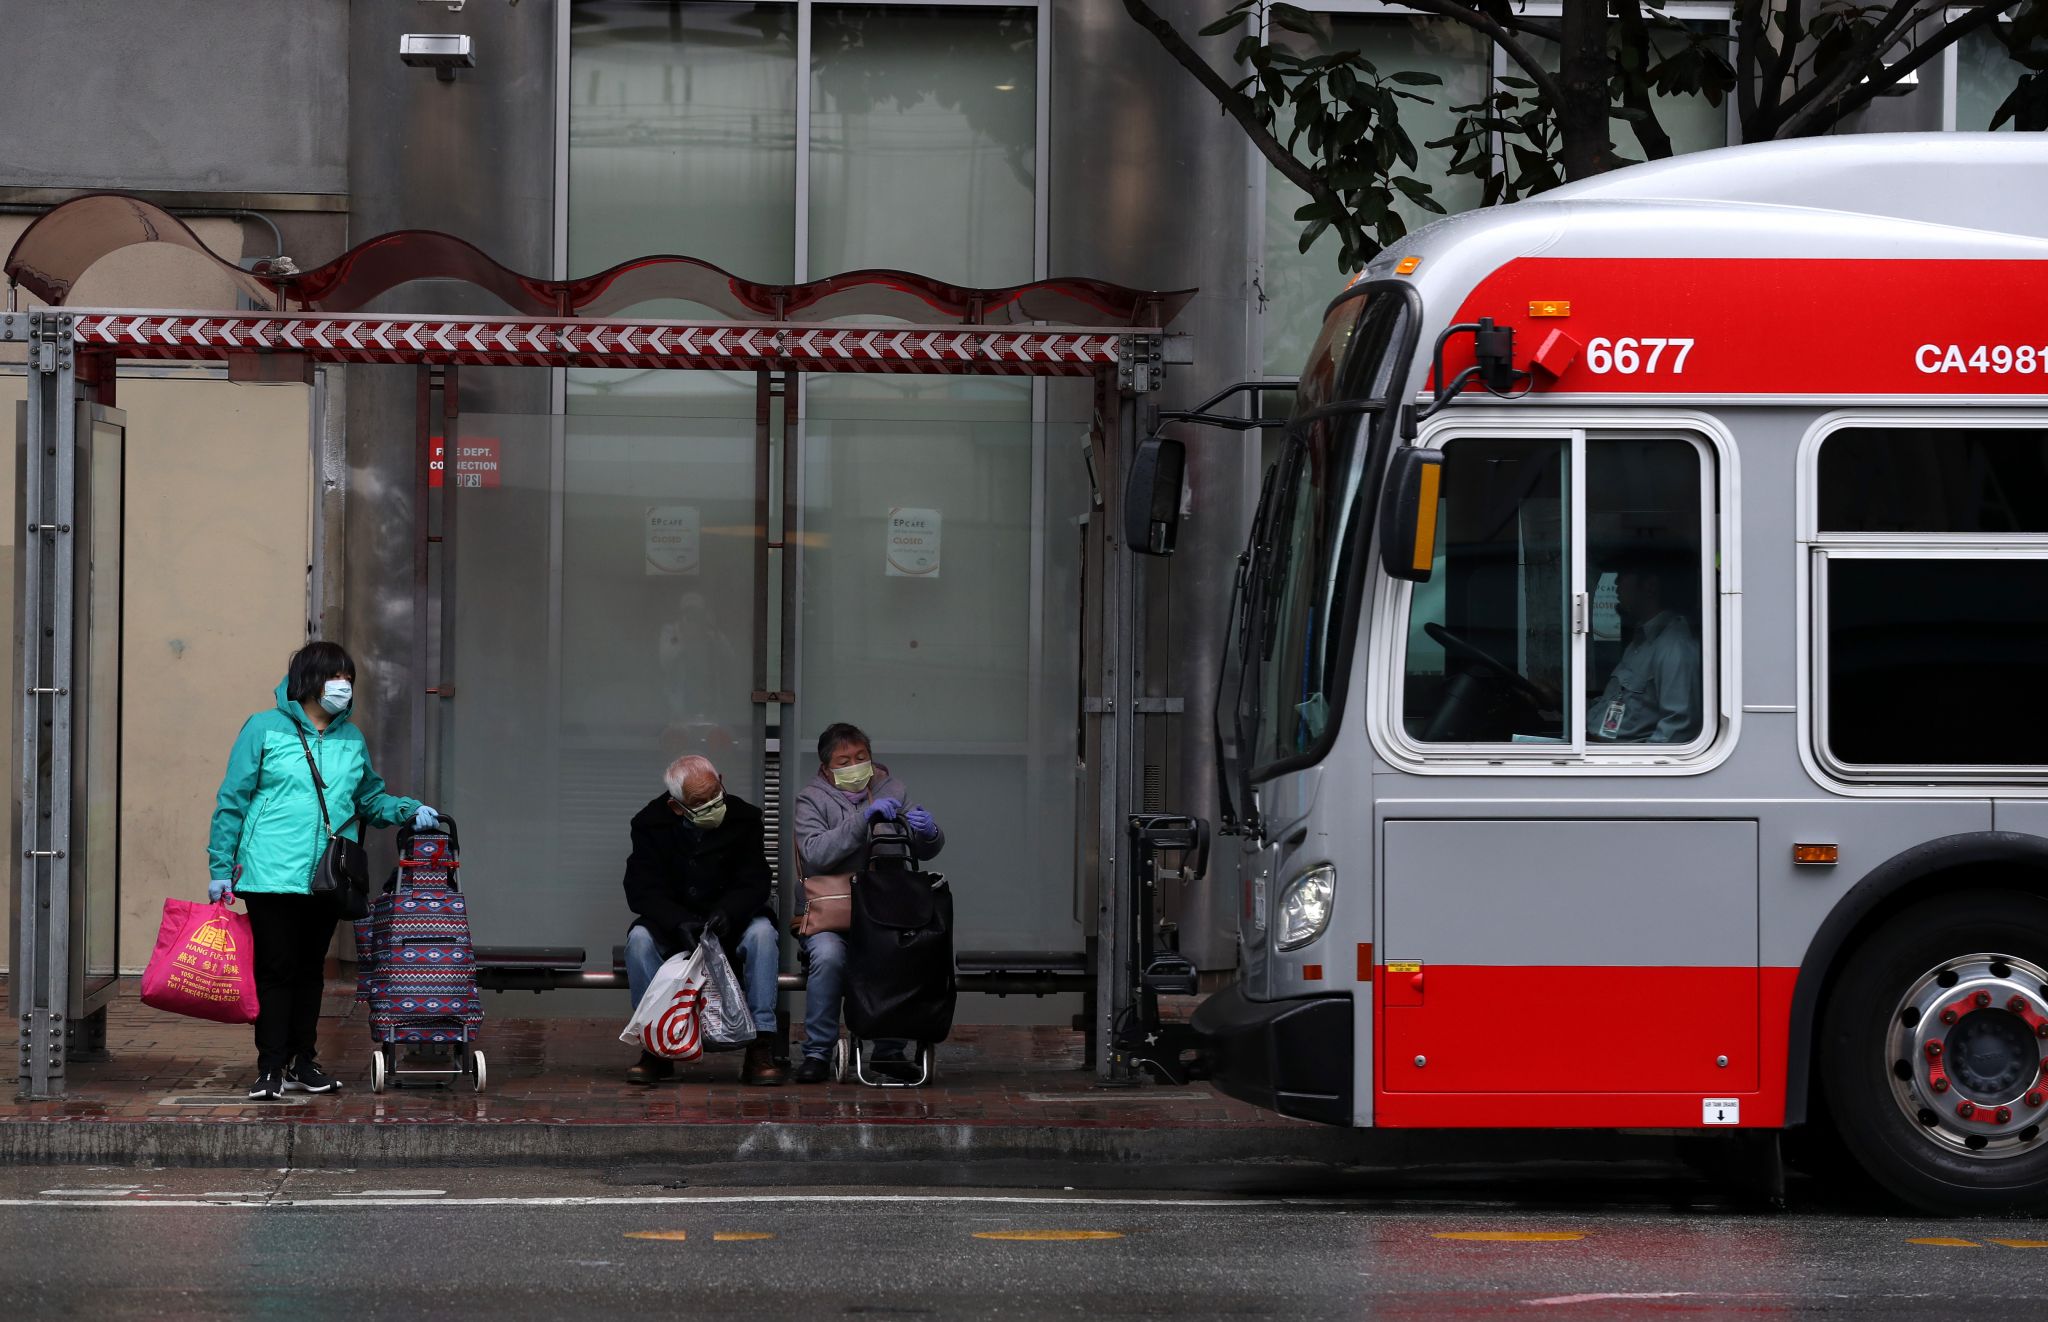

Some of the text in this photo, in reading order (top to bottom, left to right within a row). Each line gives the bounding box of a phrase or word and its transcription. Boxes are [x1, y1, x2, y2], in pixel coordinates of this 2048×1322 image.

[1586, 337, 1695, 374] 6677
[1915, 343, 2048, 374] CA4981
[463, 447, 492, 456] DEPT.
[465, 474, 481, 487] PSI
[893, 537, 924, 545] CLOSED
[185, 943, 208, 956] HANG
[169, 974, 181, 983] San
